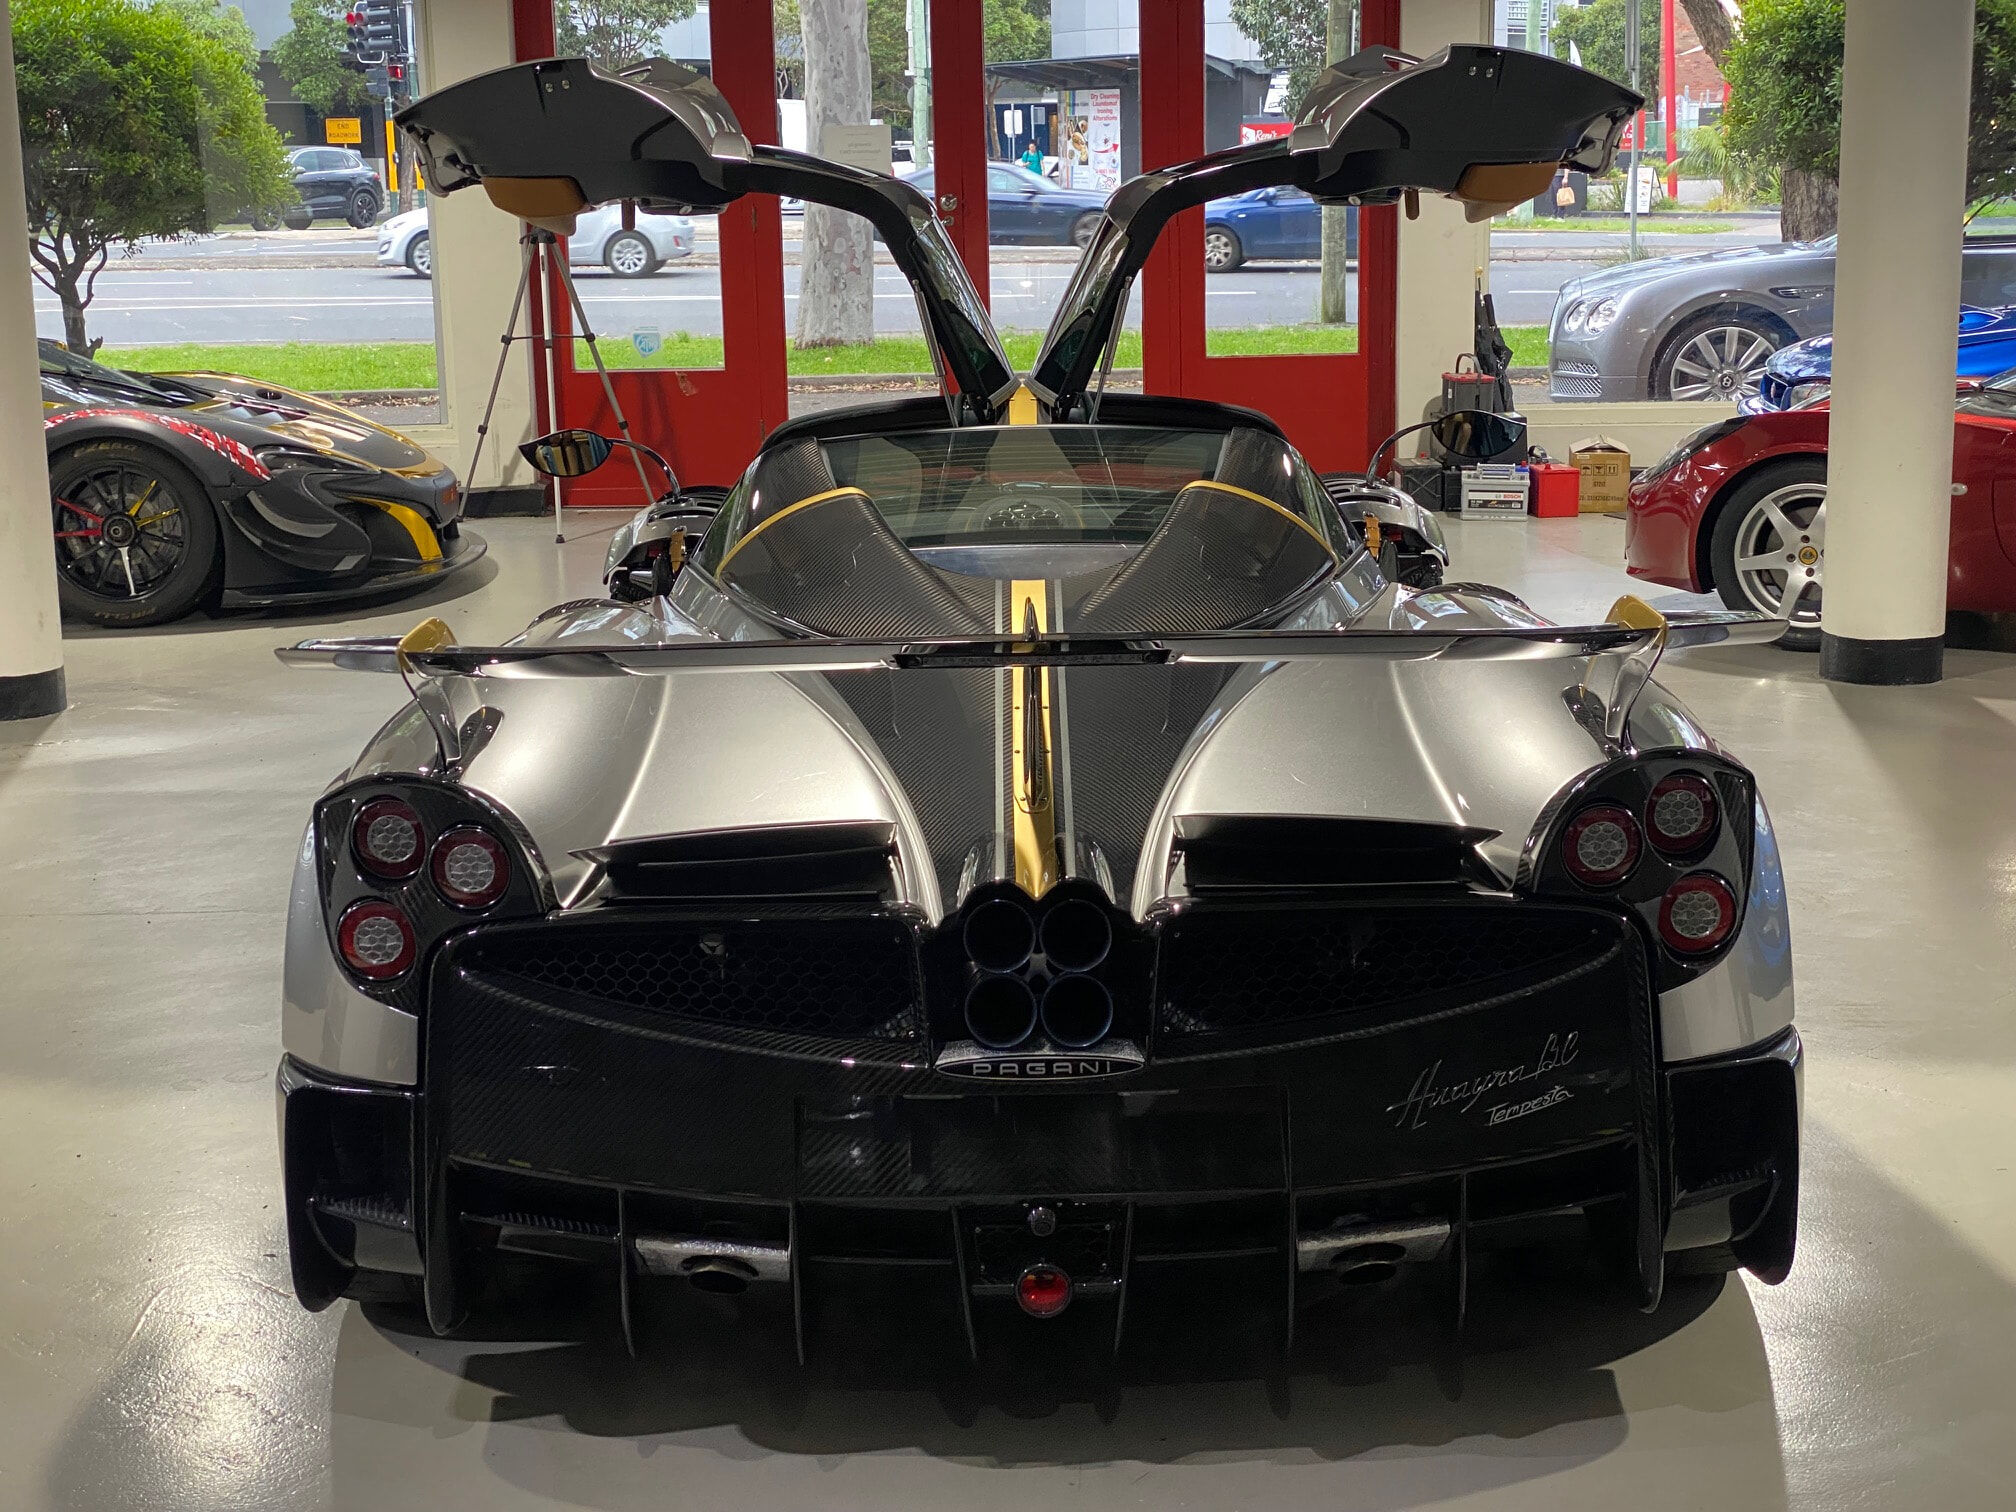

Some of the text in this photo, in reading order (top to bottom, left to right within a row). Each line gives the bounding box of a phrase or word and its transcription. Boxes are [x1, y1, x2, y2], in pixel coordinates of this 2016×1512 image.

[1090, 93, 1099, 101] Dry
[972, 1061, 1111, 1076] PAGANI
[1386, 1031, 1579, 1130] Huayra BC
[1485, 1085, 1575, 1126] Tempesta
